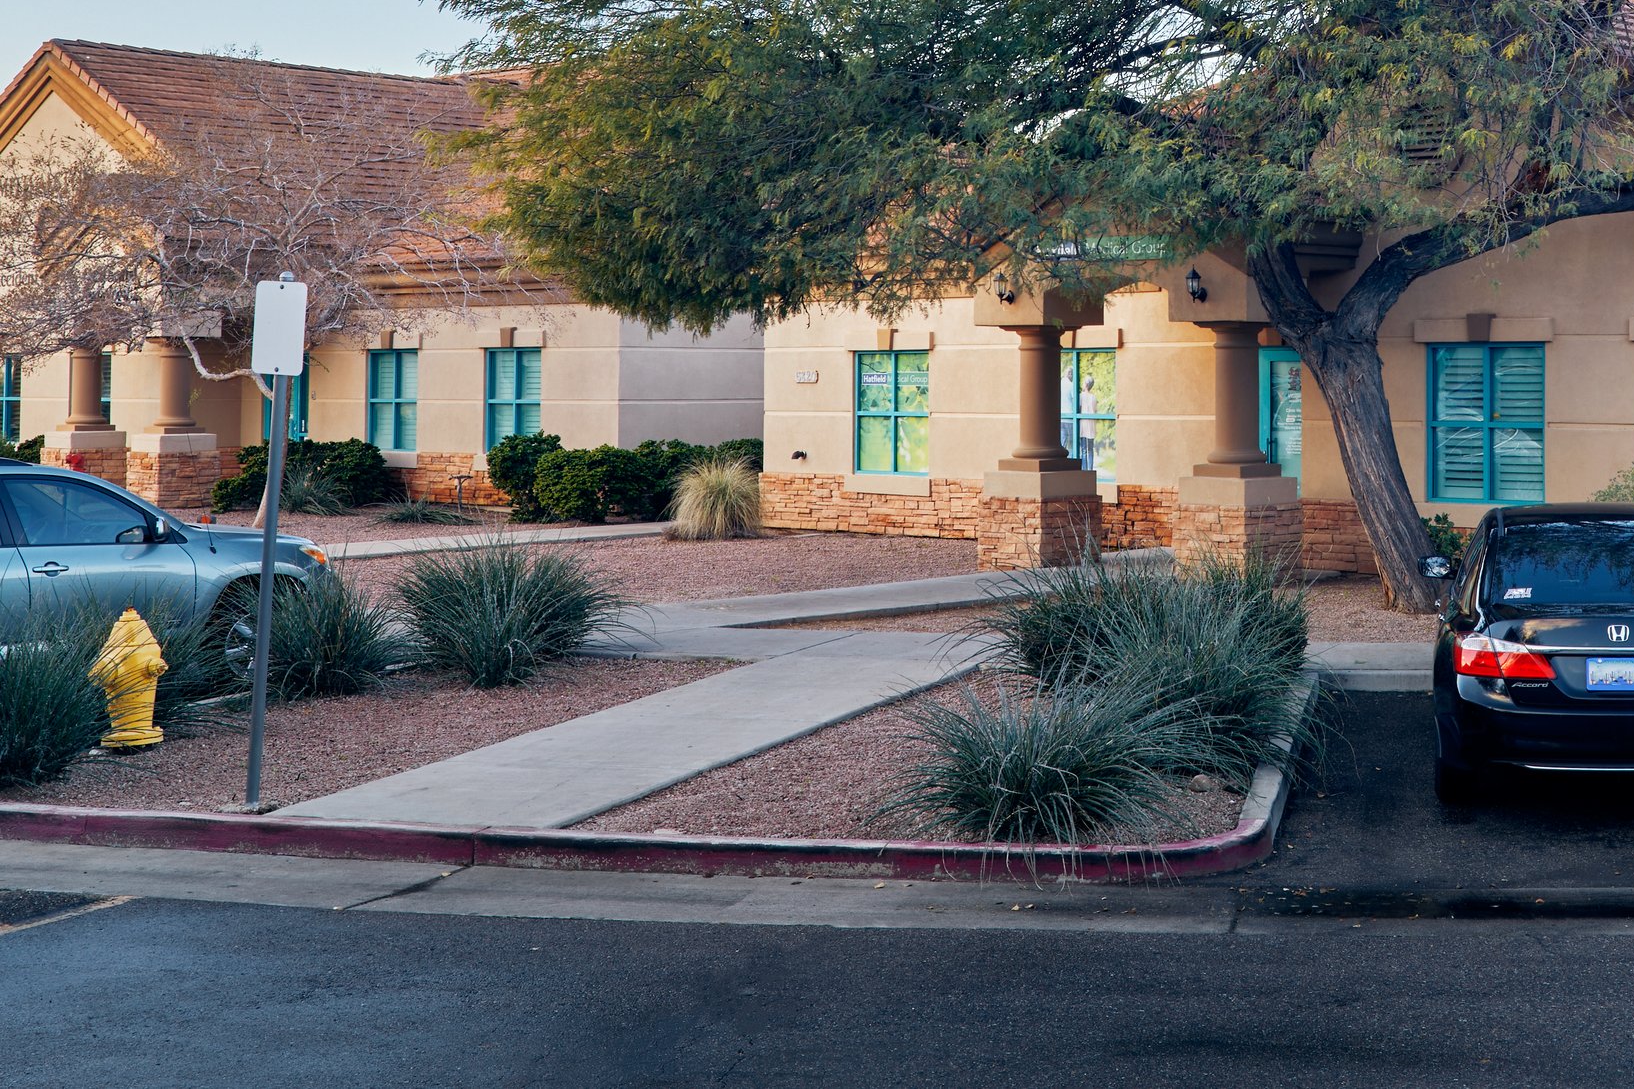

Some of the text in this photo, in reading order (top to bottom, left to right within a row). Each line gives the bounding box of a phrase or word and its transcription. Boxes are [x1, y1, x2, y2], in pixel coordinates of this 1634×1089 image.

[1131, 241, 1166, 259] Group
[863, 373, 887, 383] Hatfield
[910, 374, 928, 384] Group
